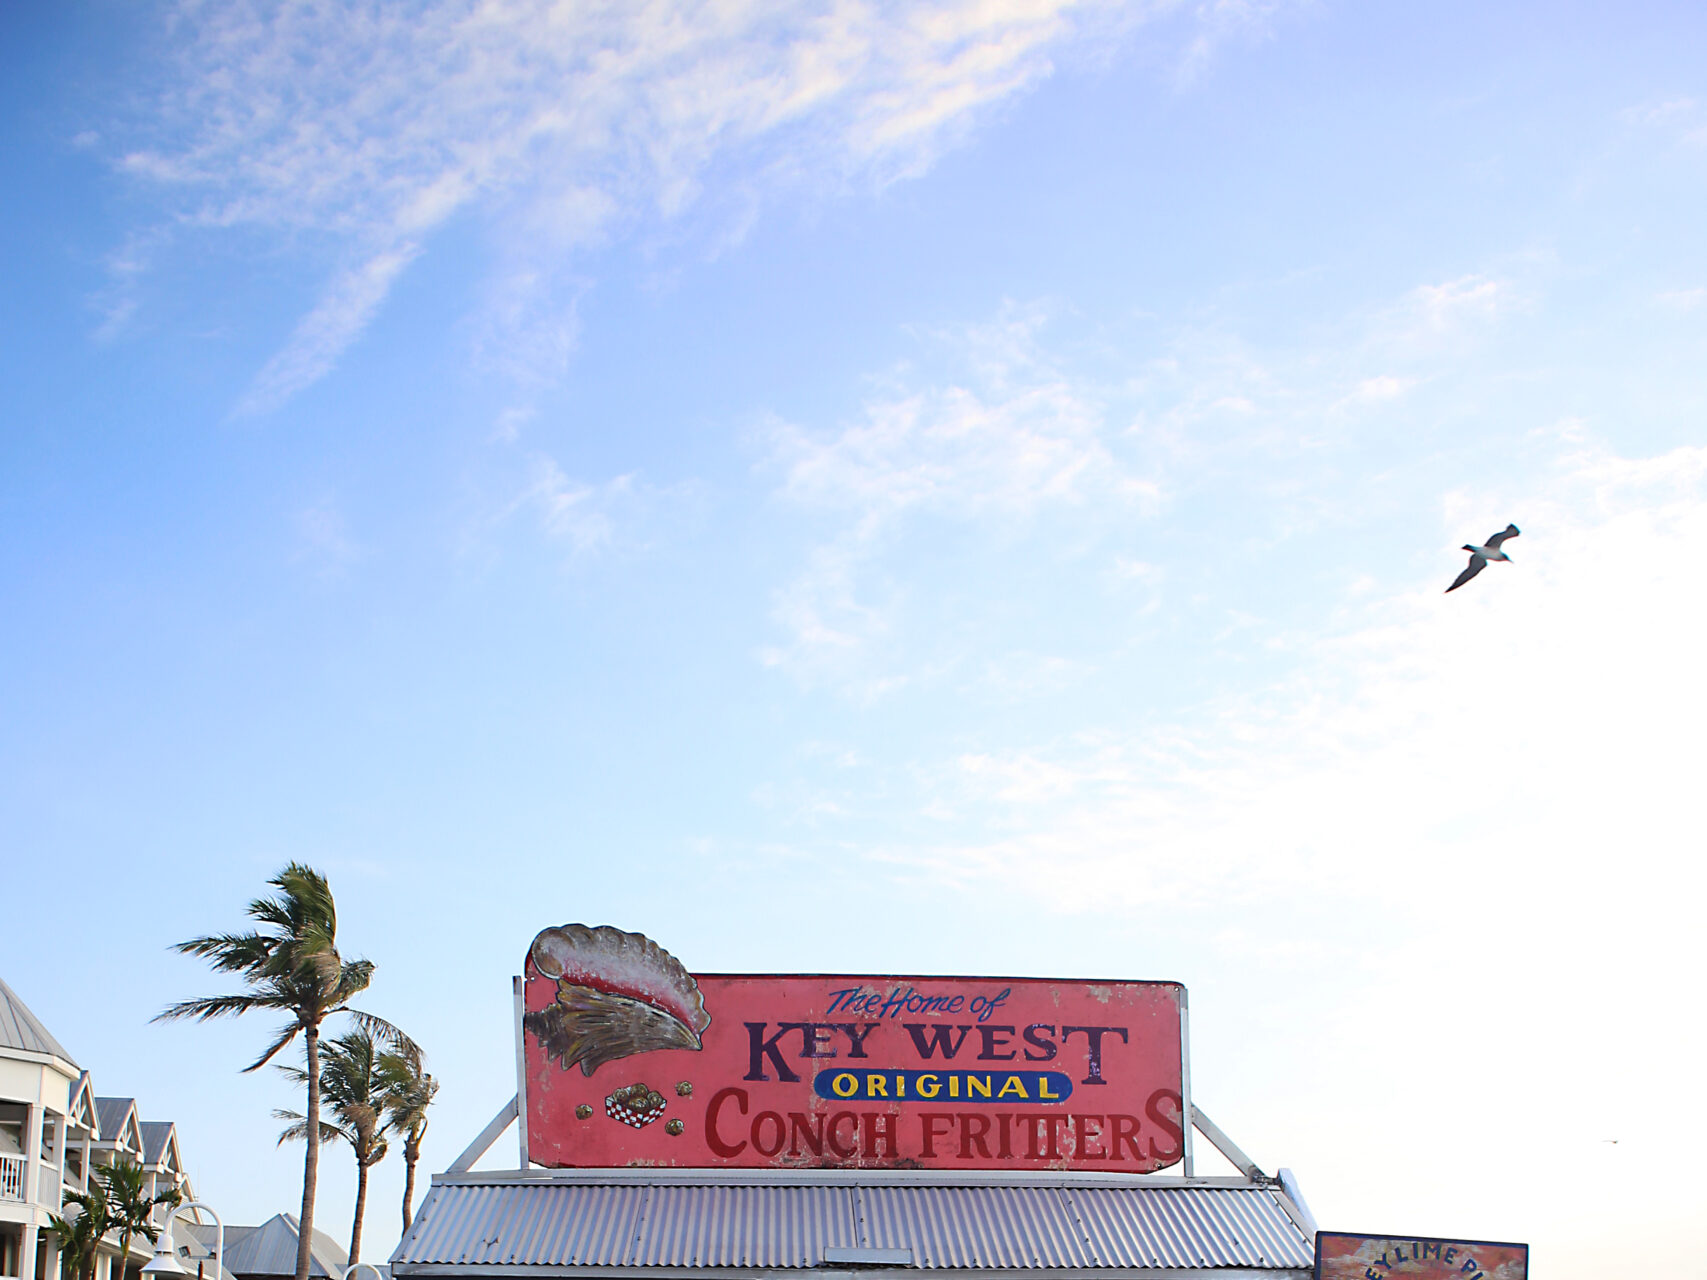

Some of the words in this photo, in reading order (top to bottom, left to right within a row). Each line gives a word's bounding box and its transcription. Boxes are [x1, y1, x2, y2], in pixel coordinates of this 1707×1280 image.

[826, 986, 883, 1015] The
[880, 989, 965, 1018] Home
[968, 986, 1012, 1021] of
[743, 1021, 880, 1082] KEY
[903, 1022, 1129, 1086] WEST
[832, 1072, 1060, 1100] ORIGINAL
[704, 1087, 896, 1160] CONCH
[917, 1088, 1184, 1161] FRITTERS
[1394, 1242, 1458, 1265] LIME
